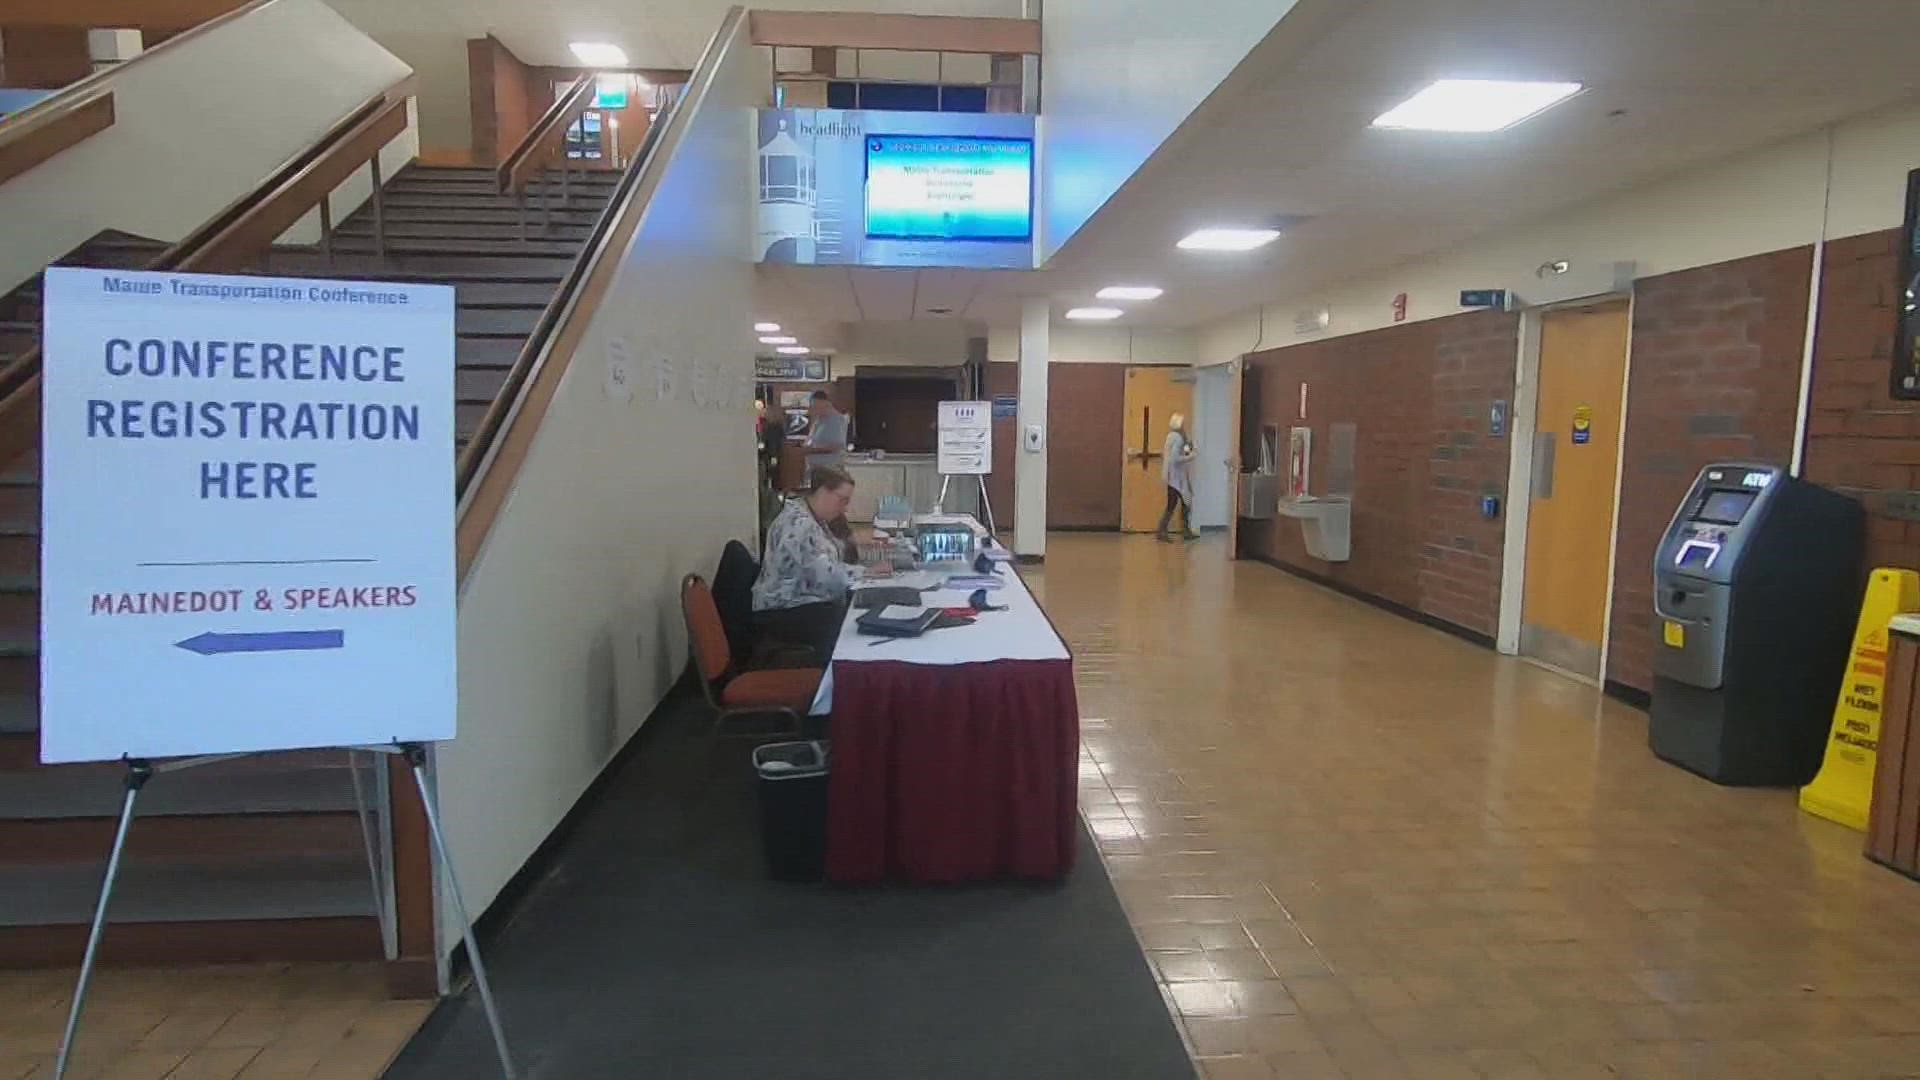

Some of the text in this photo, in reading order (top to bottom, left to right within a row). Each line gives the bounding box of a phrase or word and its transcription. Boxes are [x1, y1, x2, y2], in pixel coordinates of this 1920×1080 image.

[102, 276, 409, 305] Maine Transportation Conference
[104, 338, 405, 382] CONFERENCE
[86, 398, 420, 441] REGISTRATION
[200, 461, 318, 499] HERE
[1742, 472, 1772, 488] ATM
[90, 585, 417, 616] MAINEDOT & SPEAKERS
